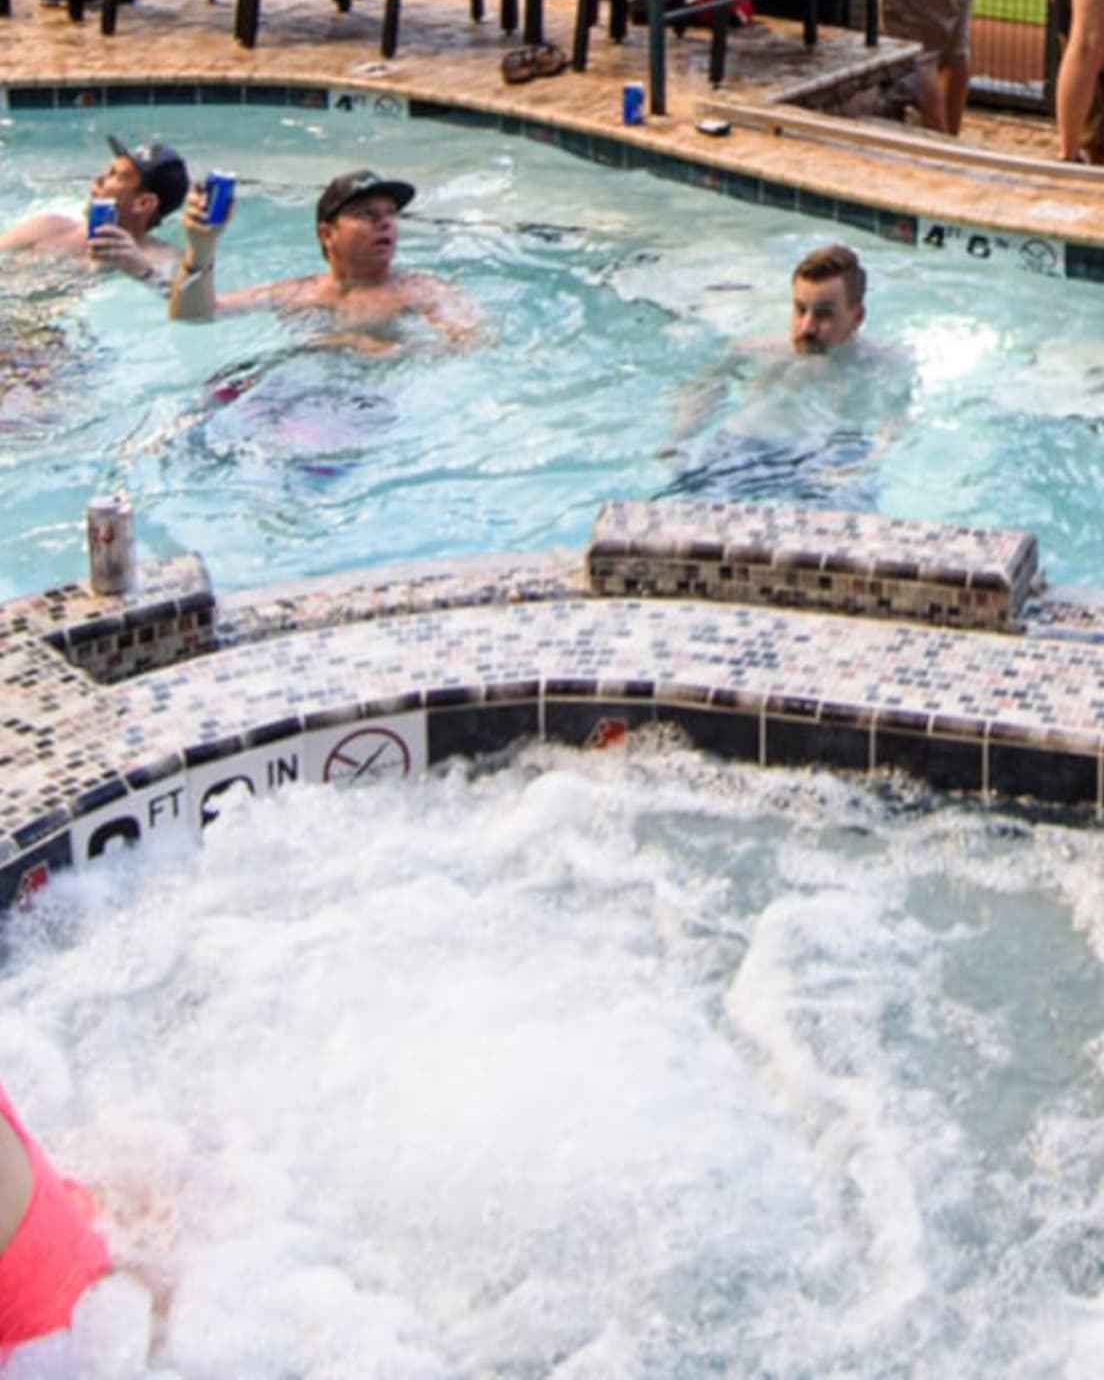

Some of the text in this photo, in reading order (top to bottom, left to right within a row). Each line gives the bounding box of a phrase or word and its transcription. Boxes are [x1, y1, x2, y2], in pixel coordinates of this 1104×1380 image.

[923, 224, 946, 248] 4
[148, 786, 186, 829] FT
[267, 754, 300, 788] IN
